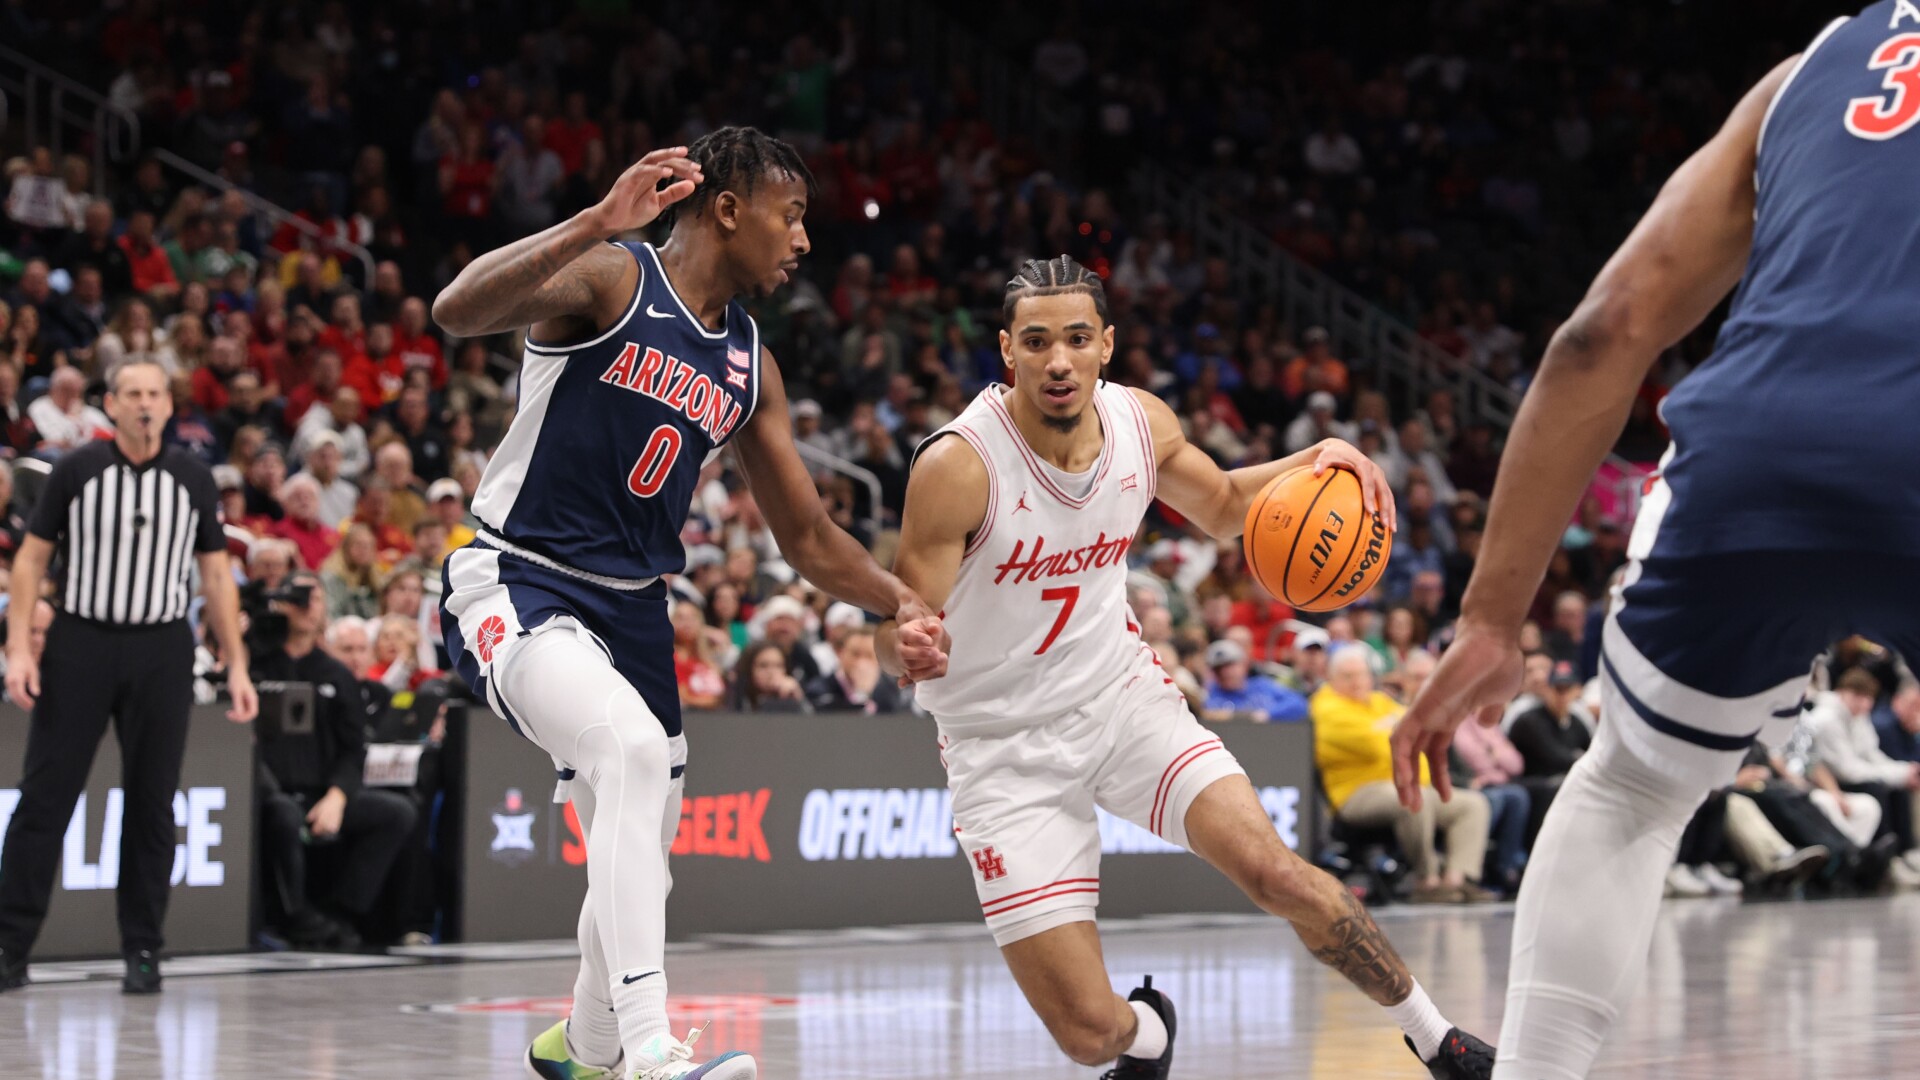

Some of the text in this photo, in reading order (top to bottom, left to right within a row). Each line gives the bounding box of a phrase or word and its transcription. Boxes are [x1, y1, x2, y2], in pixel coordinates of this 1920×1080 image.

[599, 341, 743, 446] ARIZONA
[627, 424, 682, 498] 0
[994, 531, 1133, 585] Houston
[1033, 585, 1080, 655] 7
[562, 787, 772, 866] SGEEK
[798, 788, 958, 861] OFFICIAL
